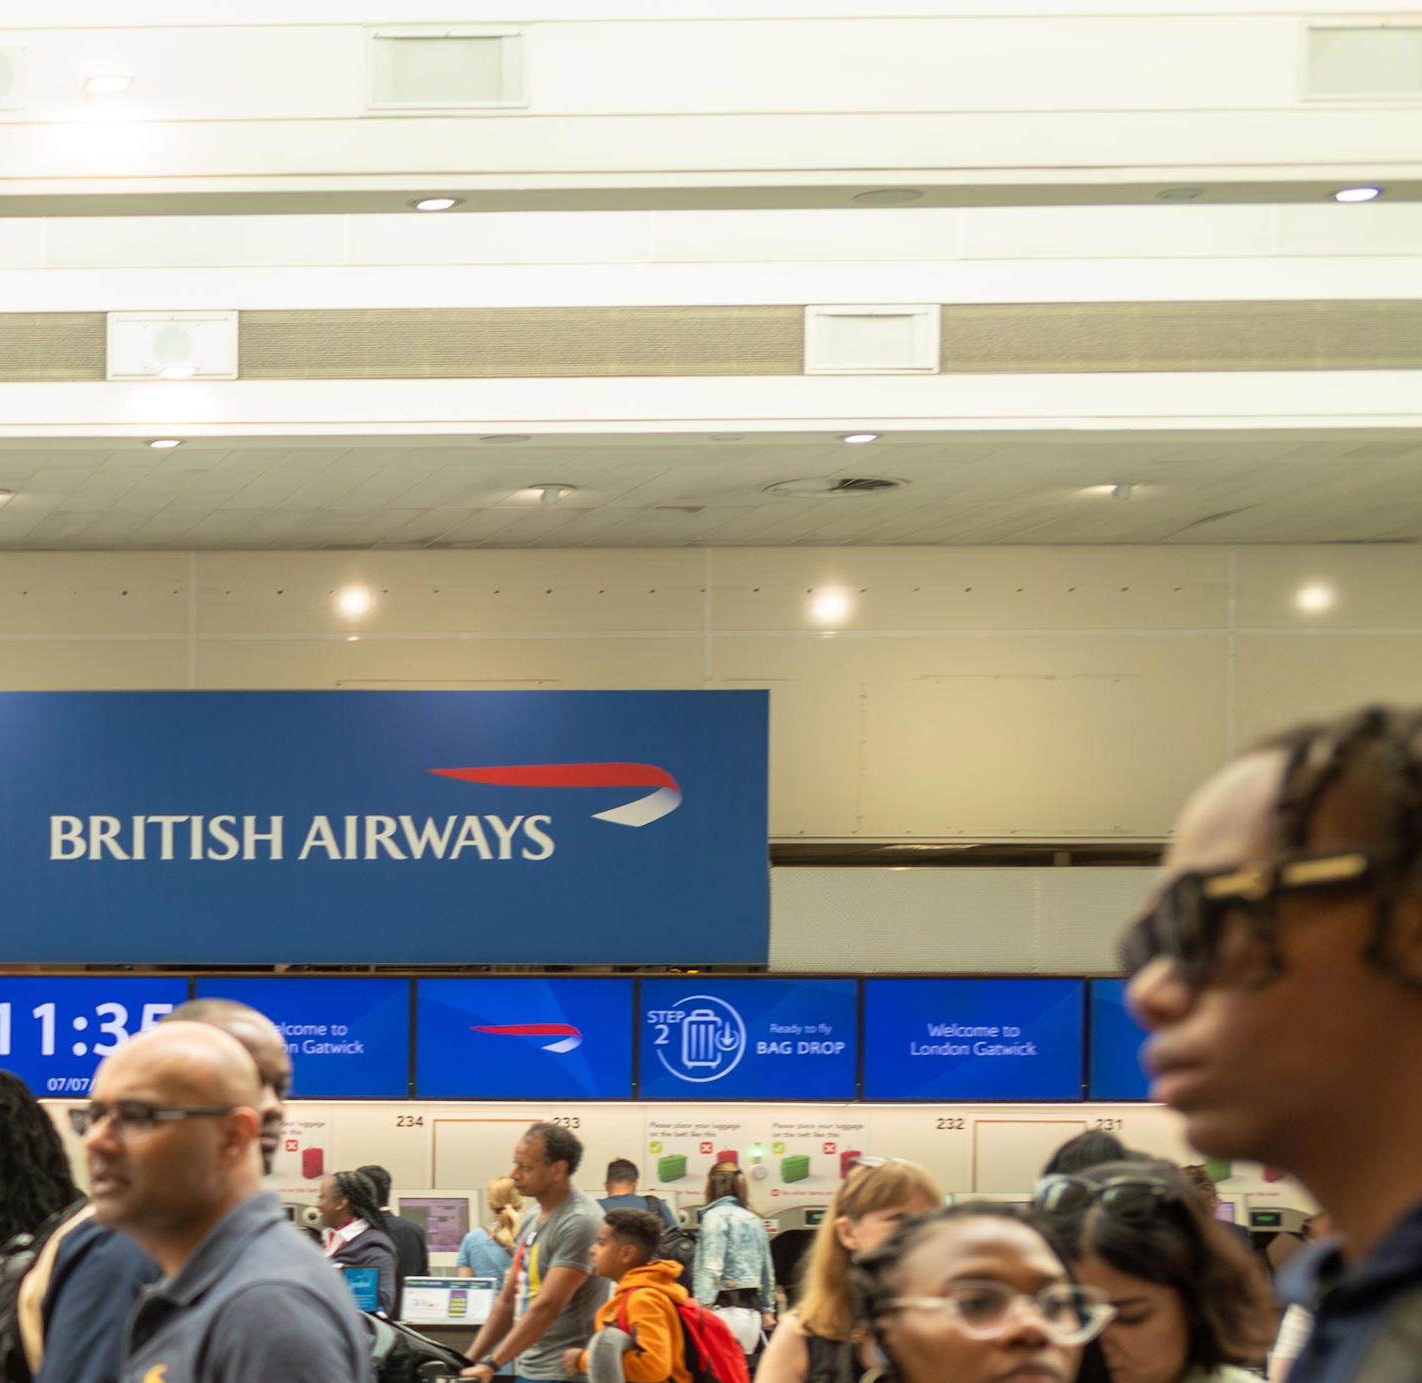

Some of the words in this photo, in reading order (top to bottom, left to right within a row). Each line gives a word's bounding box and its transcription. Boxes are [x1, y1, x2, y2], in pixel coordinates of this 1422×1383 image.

[50, 815, 283, 861] BRITISH
[298, 814, 555, 861] AIRWAYS
[647, 1010, 686, 1024] STEP
[275, 1022, 328, 1037] elcome
[330, 1024, 348, 1036] to
[653, 1024, 670, 1045] 2
[770, 1024, 803, 1036] Ready
[804, 1025, 817, 1034] to
[927, 1023, 1000, 1038] Welcome
[1002, 1025, 1021, 1038] to
[302, 1039, 364, 1055] Gatwick
[756, 1040, 793, 1055] BAG
[797, 1041, 846, 1055] DROP
[910, 1041, 970, 1056] London
[972, 1041, 1038, 1057] Gatwick
[396, 1115, 424, 1128] 234
[936, 1117, 965, 1130] 232
